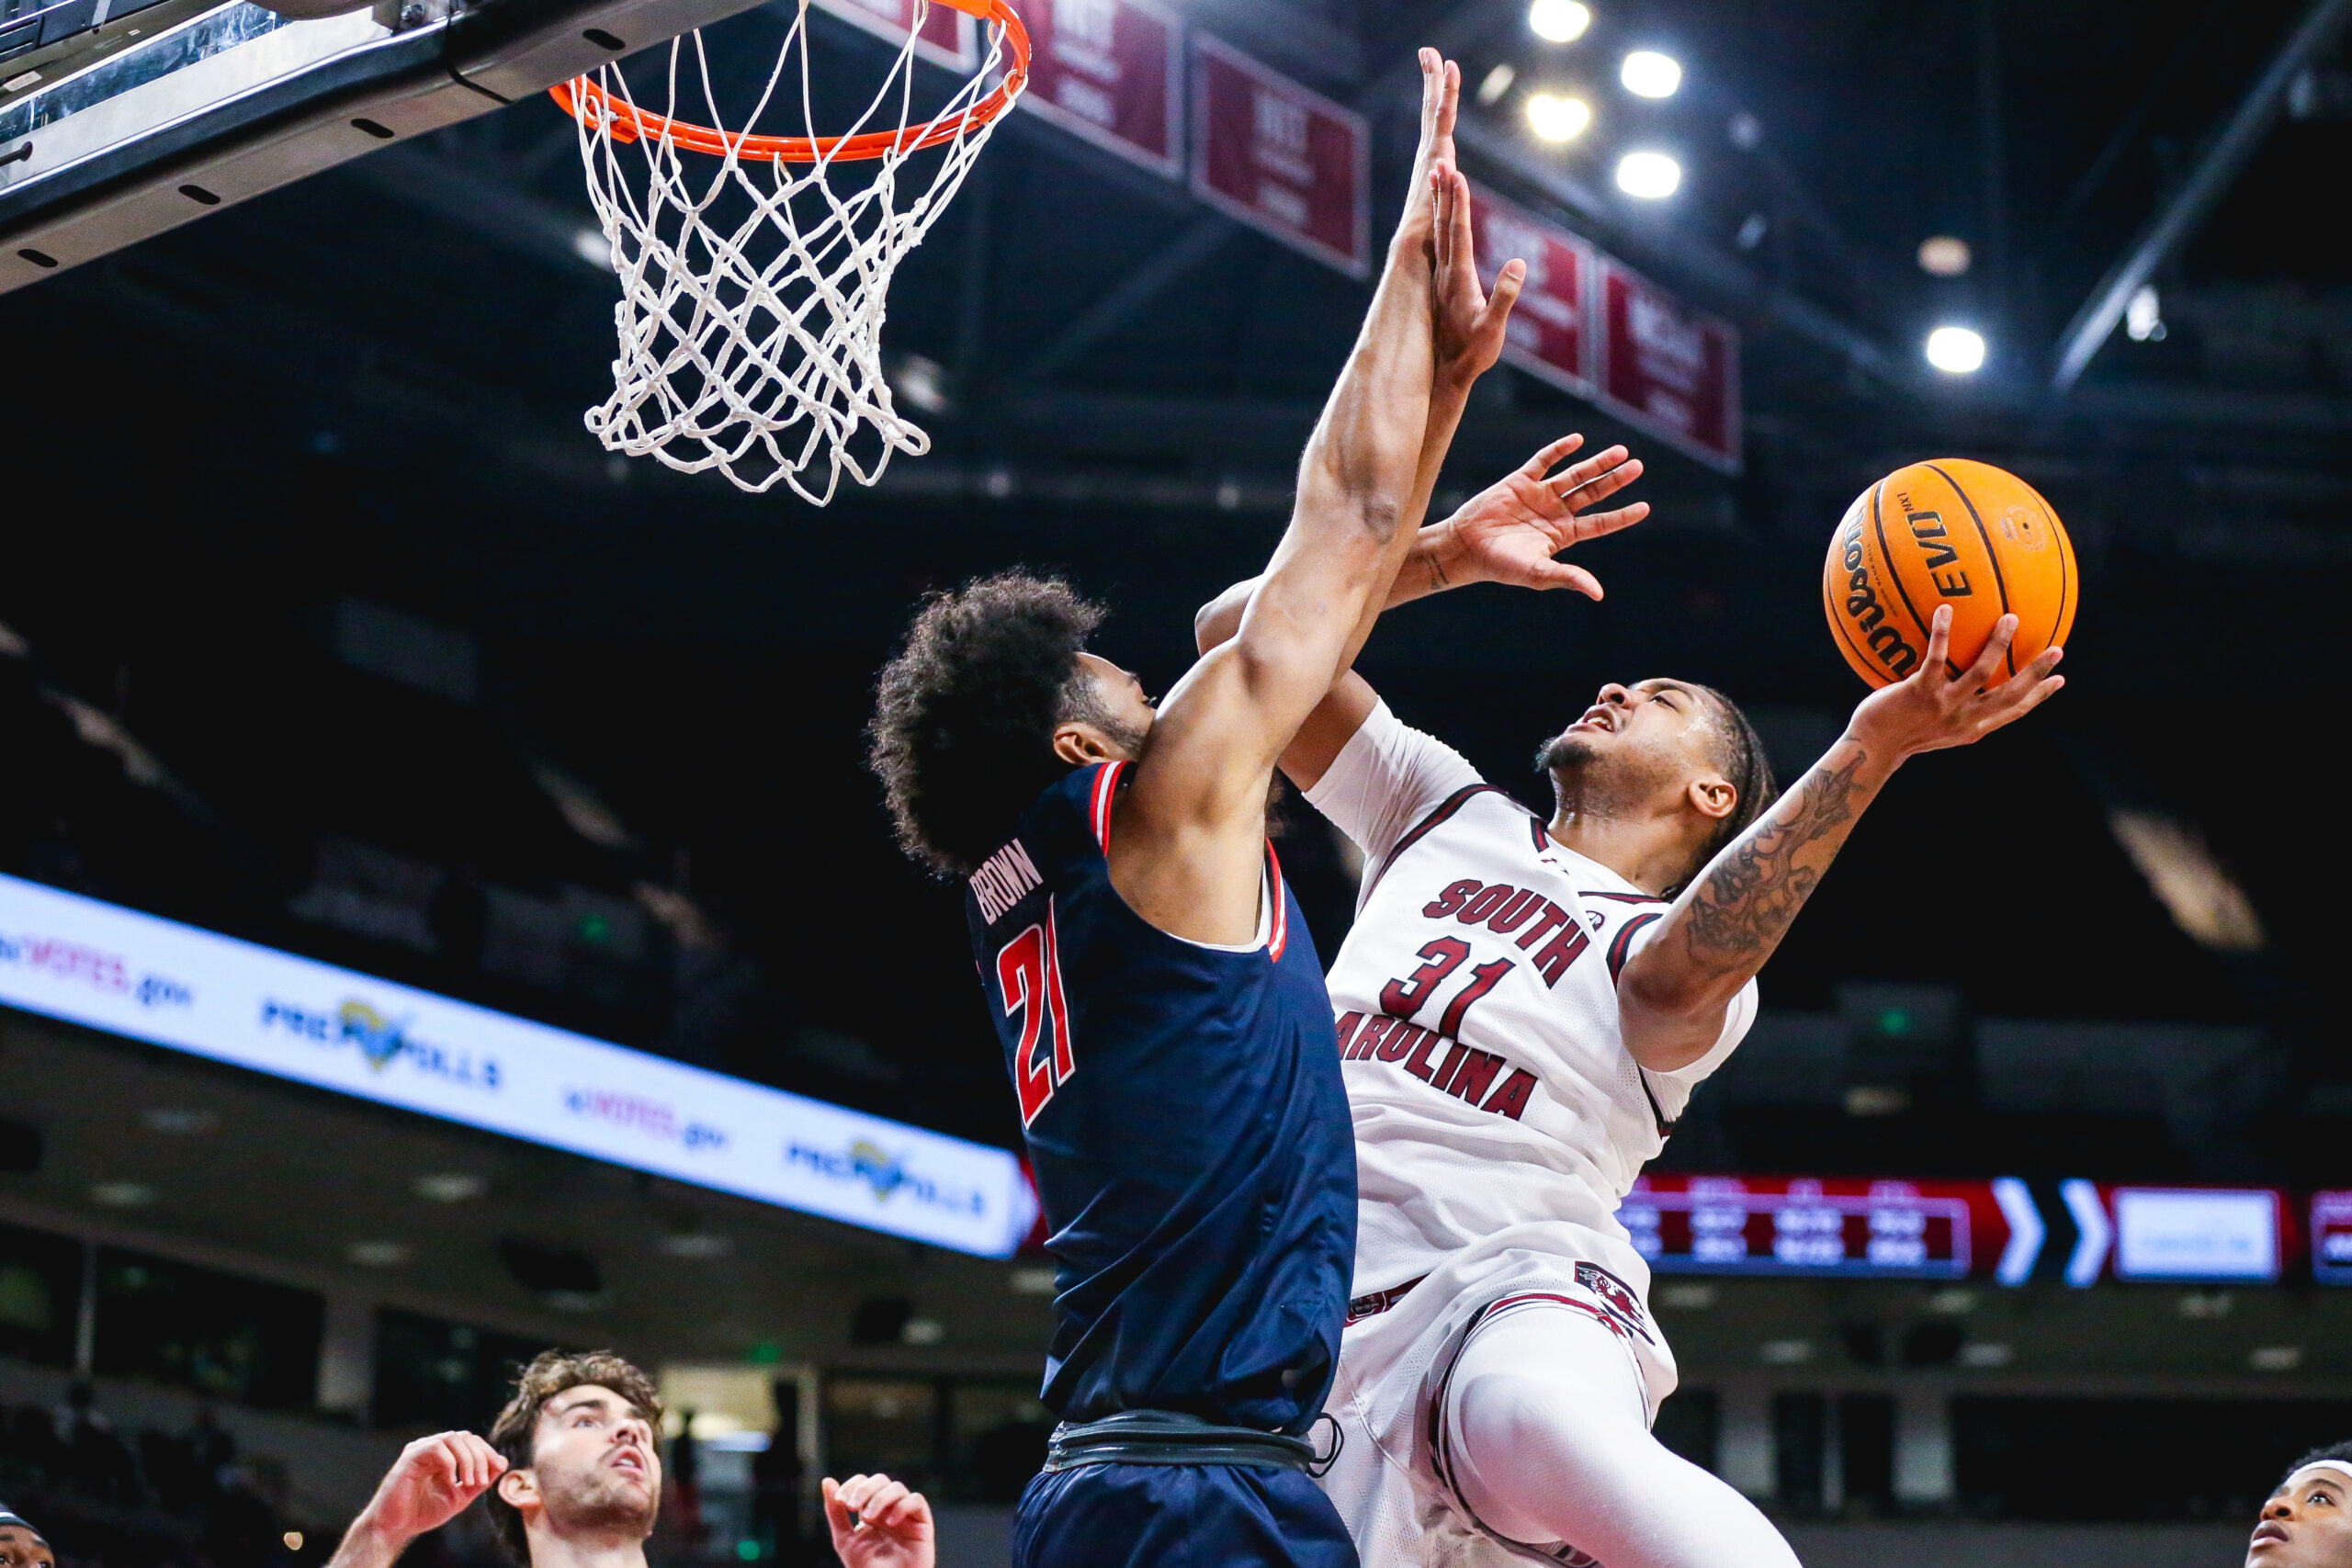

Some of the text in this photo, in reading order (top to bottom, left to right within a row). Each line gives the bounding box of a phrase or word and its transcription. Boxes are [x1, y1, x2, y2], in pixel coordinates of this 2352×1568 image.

[1843, 506, 1918, 678] Wilson
[1871, 564, 1882, 587] GAME
[1896, 491, 1973, 597] EVO NXT
[969, 838, 1044, 925] BROWN
[1421, 878, 1590, 989] SOUTH
[997, 892, 1076, 1131] 21
[1379, 935, 1517, 1043] 31
[1335, 1010, 1538, 1122] AROLINA
